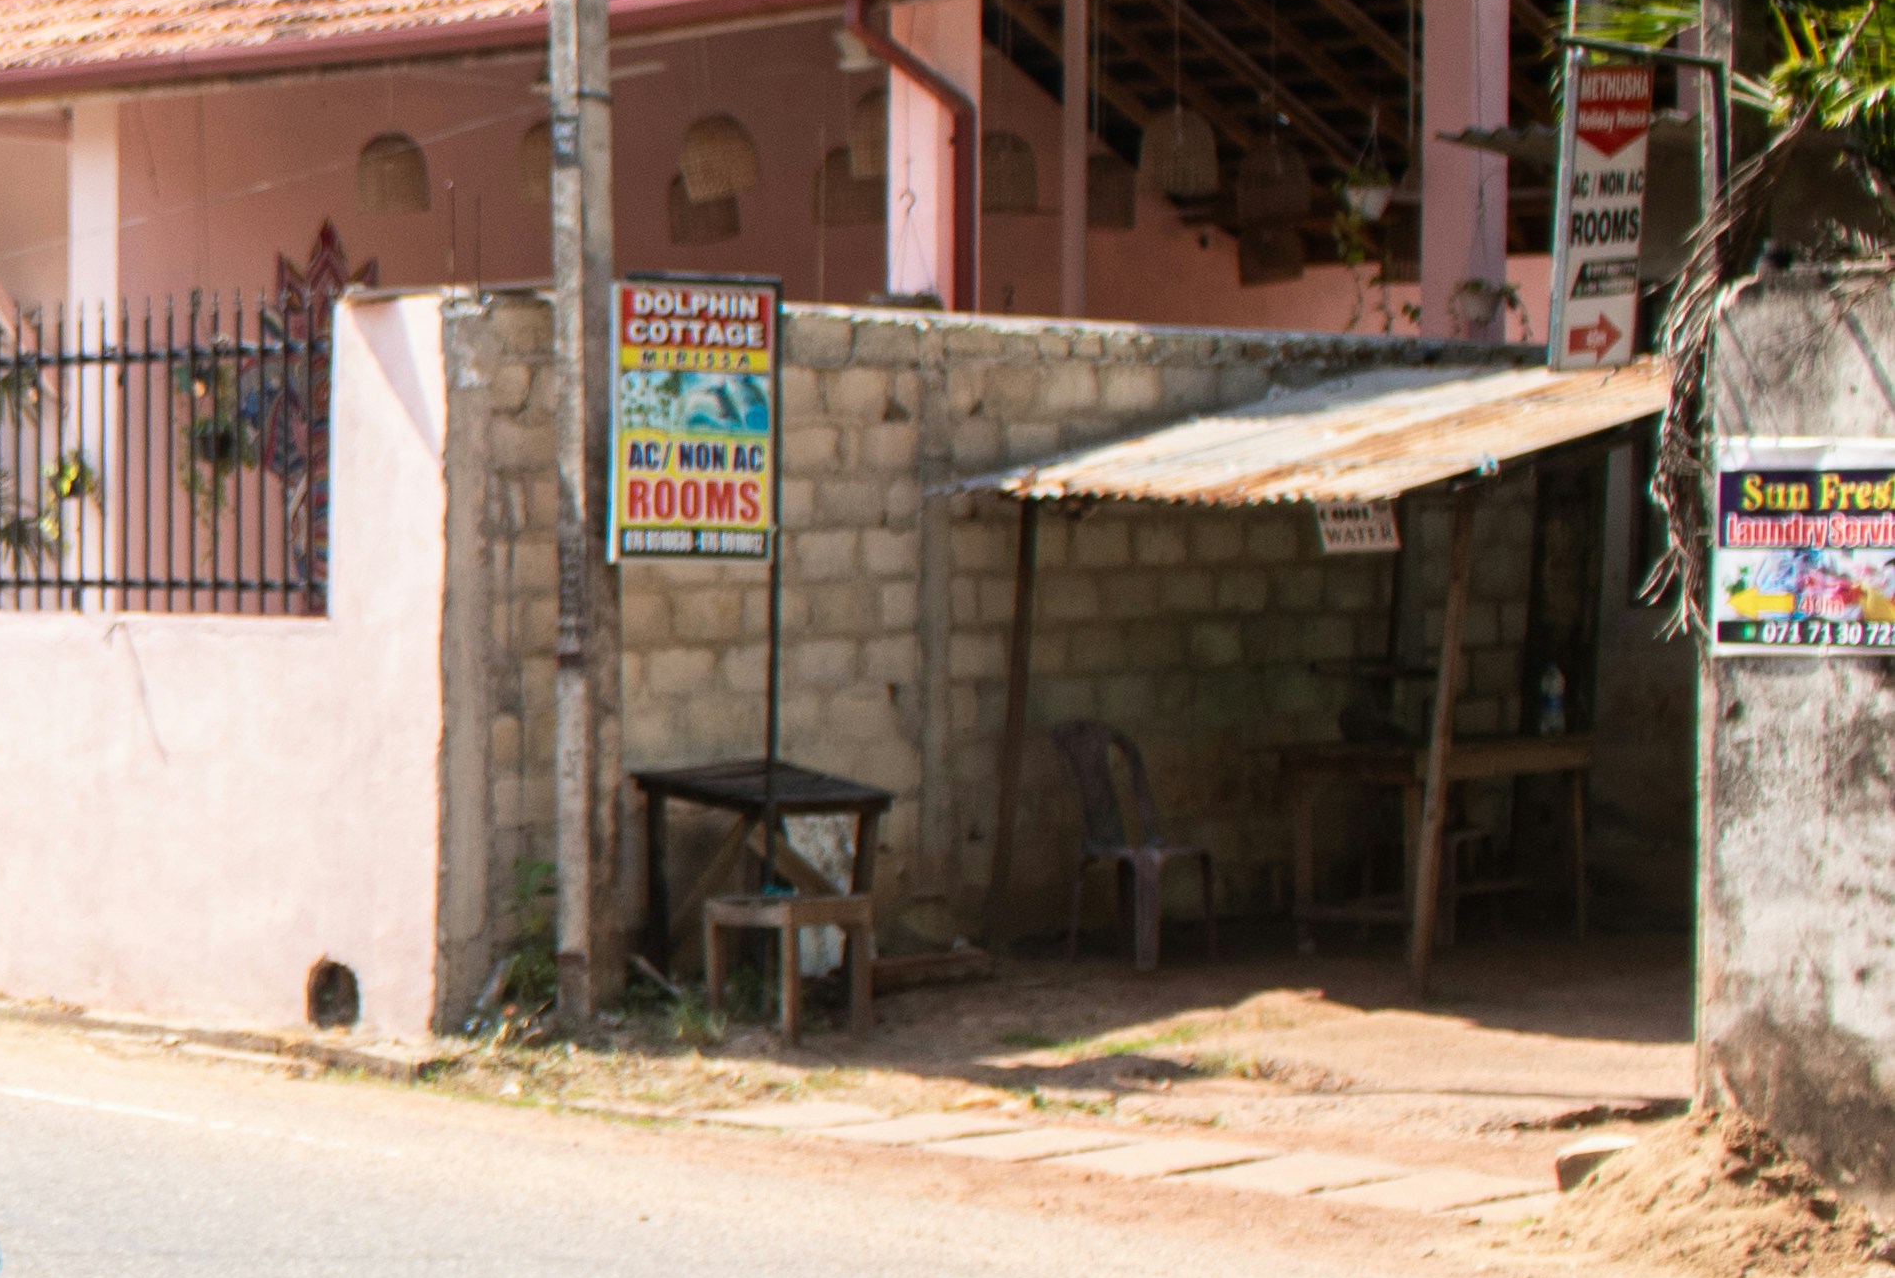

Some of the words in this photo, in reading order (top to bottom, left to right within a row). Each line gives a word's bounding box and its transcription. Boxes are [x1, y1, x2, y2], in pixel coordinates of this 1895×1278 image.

[1599, 171, 1625, 196] NON
[1627, 169, 1645, 195] AC
[1571, 207, 1640, 246] ROOMS
[632, 290, 760, 320] DOLPHIN
[627, 321, 766, 348] COTTAGE
[678, 442, 728, 472] NON
[732, 443, 766, 473] AC
[627, 478, 762, 522] ROOMS
[1740, 472, 1811, 511] Sun
[1818, 471, 1895, 511] Fres
[1726, 510, 1828, 549] Laundry
[1762, 621, 1802, 644] 071
[1808, 621, 1833, 644] 71
[1837, 621, 1864, 644] 30
